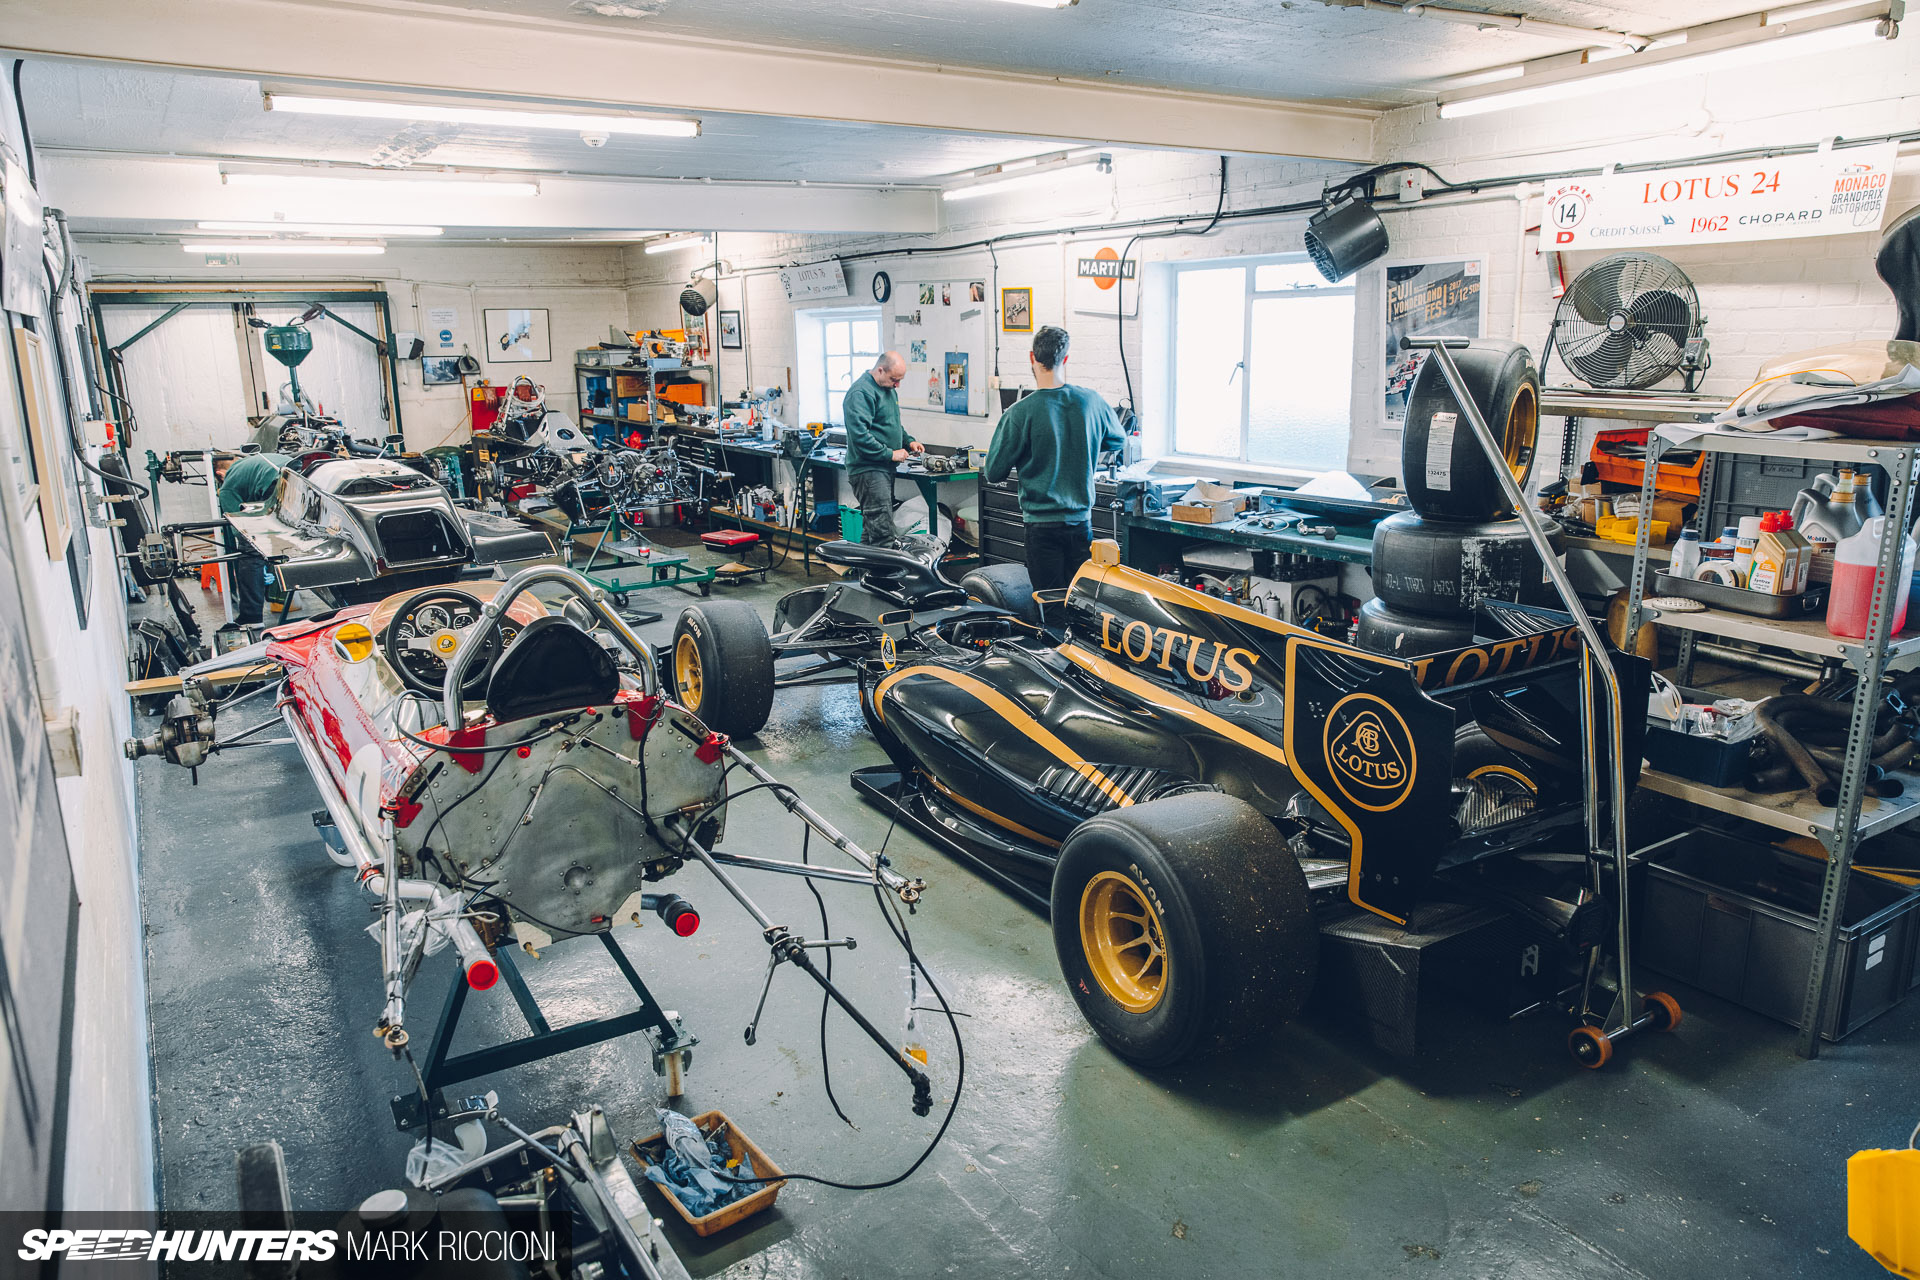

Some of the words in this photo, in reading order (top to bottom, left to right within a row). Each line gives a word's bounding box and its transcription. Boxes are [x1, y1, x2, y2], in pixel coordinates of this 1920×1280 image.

[1643, 174, 1740, 204] LOTUS
[1751, 170, 1781, 195] 24
[1834, 173, 1887, 193] MONACO
[1548, 185, 1593, 205] SERIE
[1560, 203, 1577, 223] 14
[1738, 209, 1823, 225] CHOPARD
[1690, 215, 1729, 233] 1962
[1556, 231, 1575, 244] D
[1079, 261, 1134, 276] MARTINI
[1388, 280, 1413, 323] FUJI
[1448, 287, 1469, 306] 3/12
[1101, 612, 1261, 692] LOTUS
[1336, 744, 1401, 780] LOTUS
[1129, 863, 1165, 916] AVON
